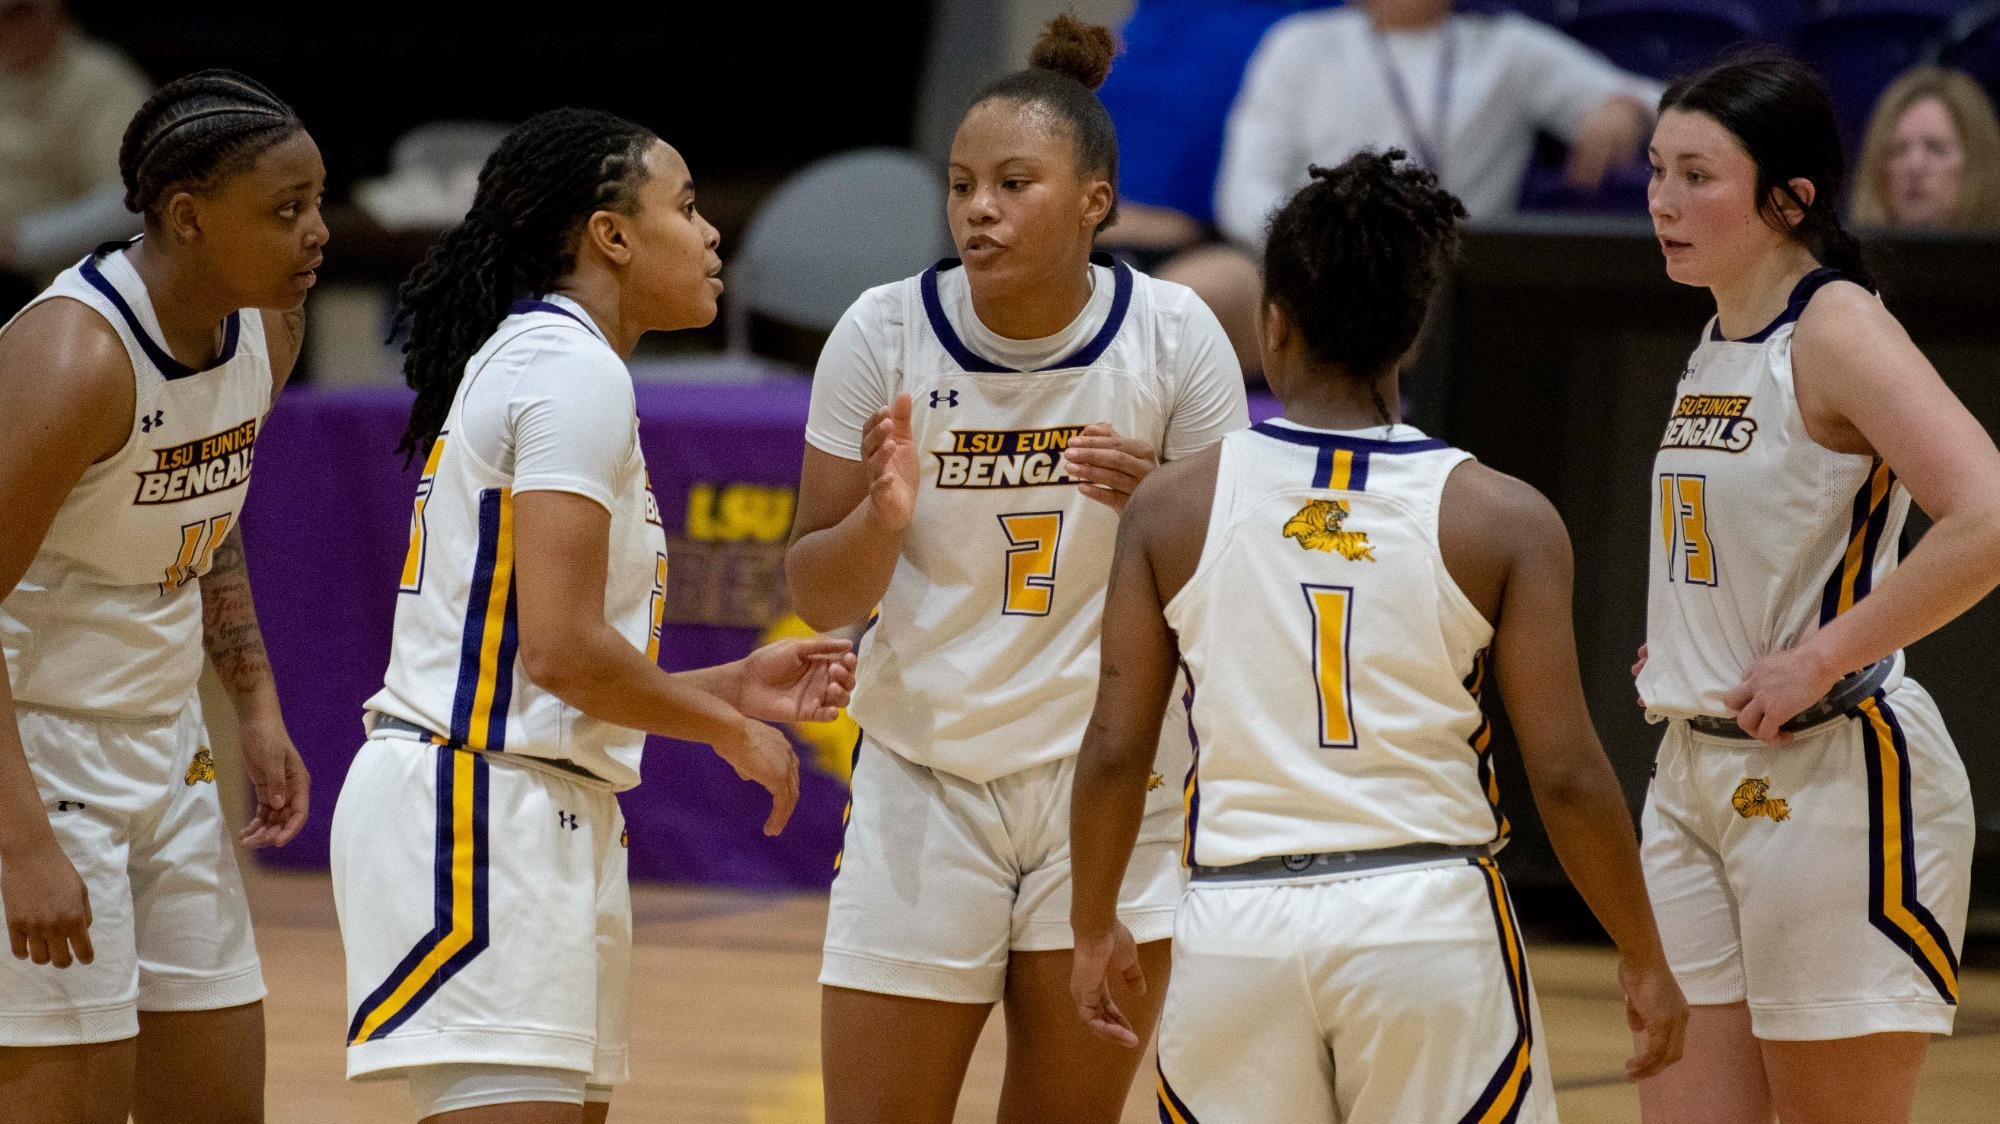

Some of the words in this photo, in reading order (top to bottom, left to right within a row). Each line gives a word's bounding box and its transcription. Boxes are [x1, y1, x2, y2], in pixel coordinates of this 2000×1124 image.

[159, 445, 194, 471] LSU
[201, 421, 255, 460] EUNICE
[957, 433, 1004, 453] LSU
[1661, 416, 1753, 451] ENGALS
[139, 446, 254, 502] BENGAL
[940, 451, 1079, 486] BENGA
[158, 511, 233, 597] 11
[1659, 472, 1718, 588] 13
[997, 510, 1064, 617] 2
[1300, 582, 1359, 750] 1
